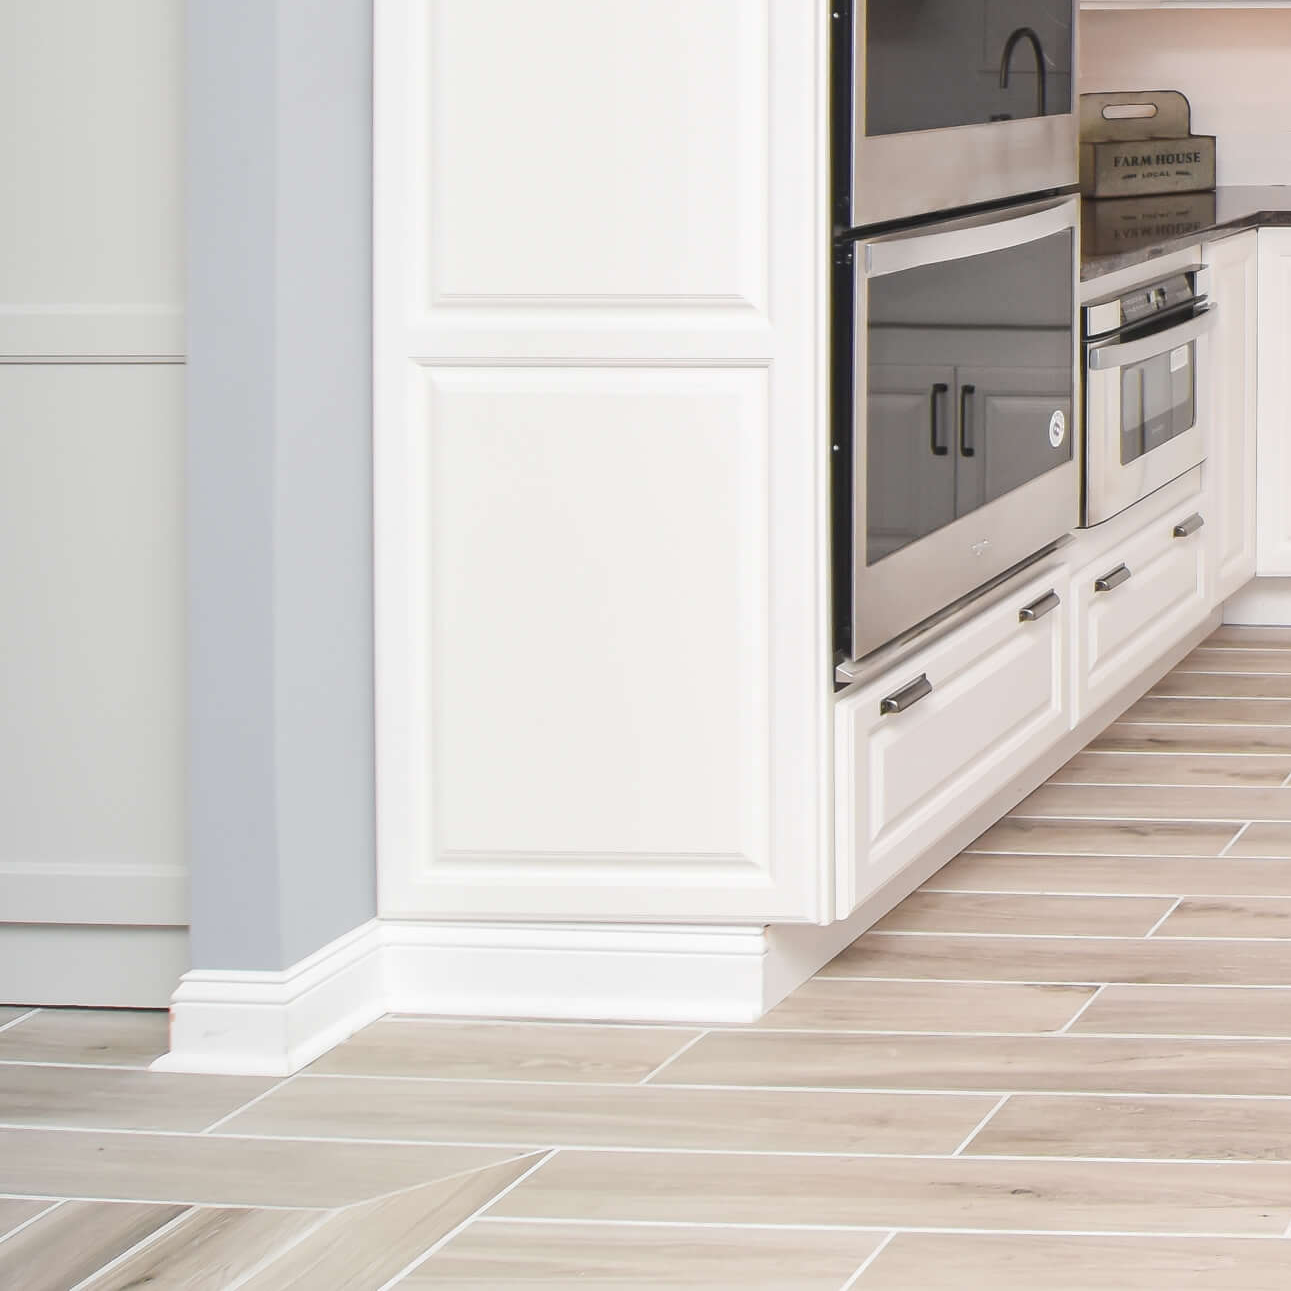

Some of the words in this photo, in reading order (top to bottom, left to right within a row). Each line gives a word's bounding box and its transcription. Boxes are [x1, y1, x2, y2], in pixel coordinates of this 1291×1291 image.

[1113, 155, 1152, 168] FARM
[1155, 151, 1201, 166] HOUSE
[1142, 170, 1170, 178] LOCAL
